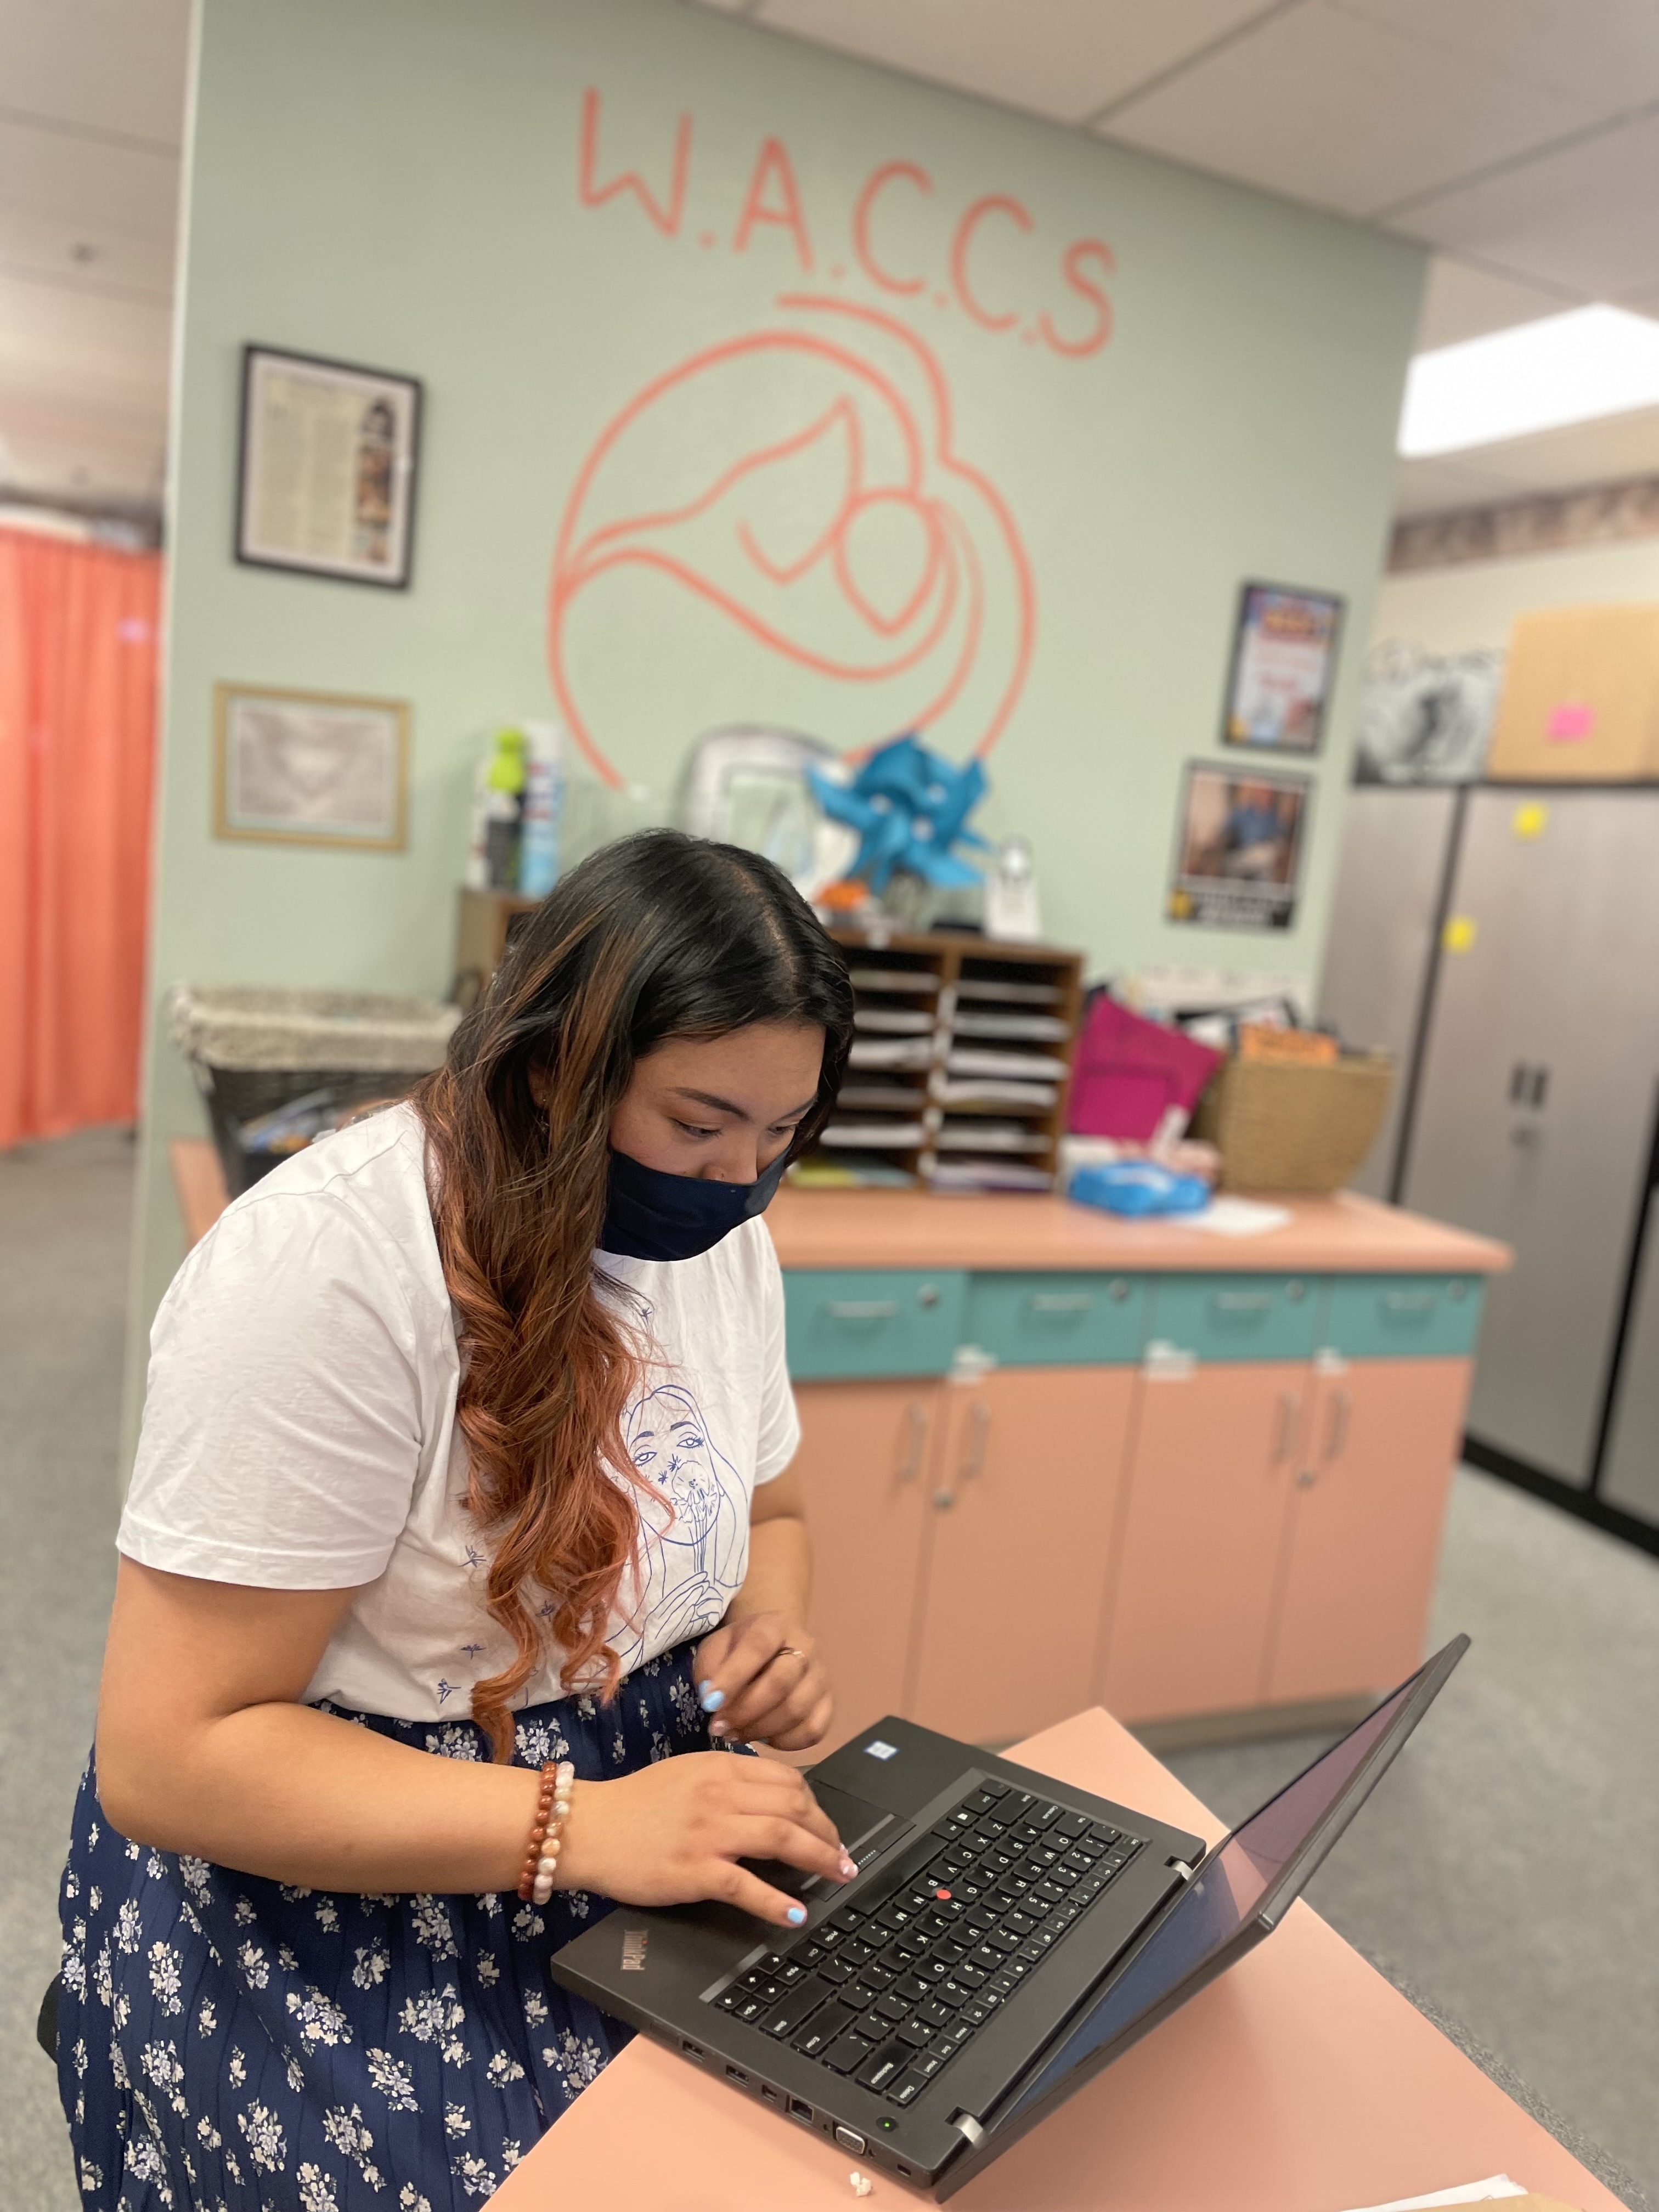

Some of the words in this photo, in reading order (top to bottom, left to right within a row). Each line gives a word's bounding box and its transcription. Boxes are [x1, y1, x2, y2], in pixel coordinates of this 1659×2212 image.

[622, 1930, 648, 1970] ThinkPad
[806, 2036, 820, 2048] Enter
[924, 2061, 938, 2072] Insert
[871, 2063, 893, 2084] Backspace
[900, 2086, 914, 2098] Delete
